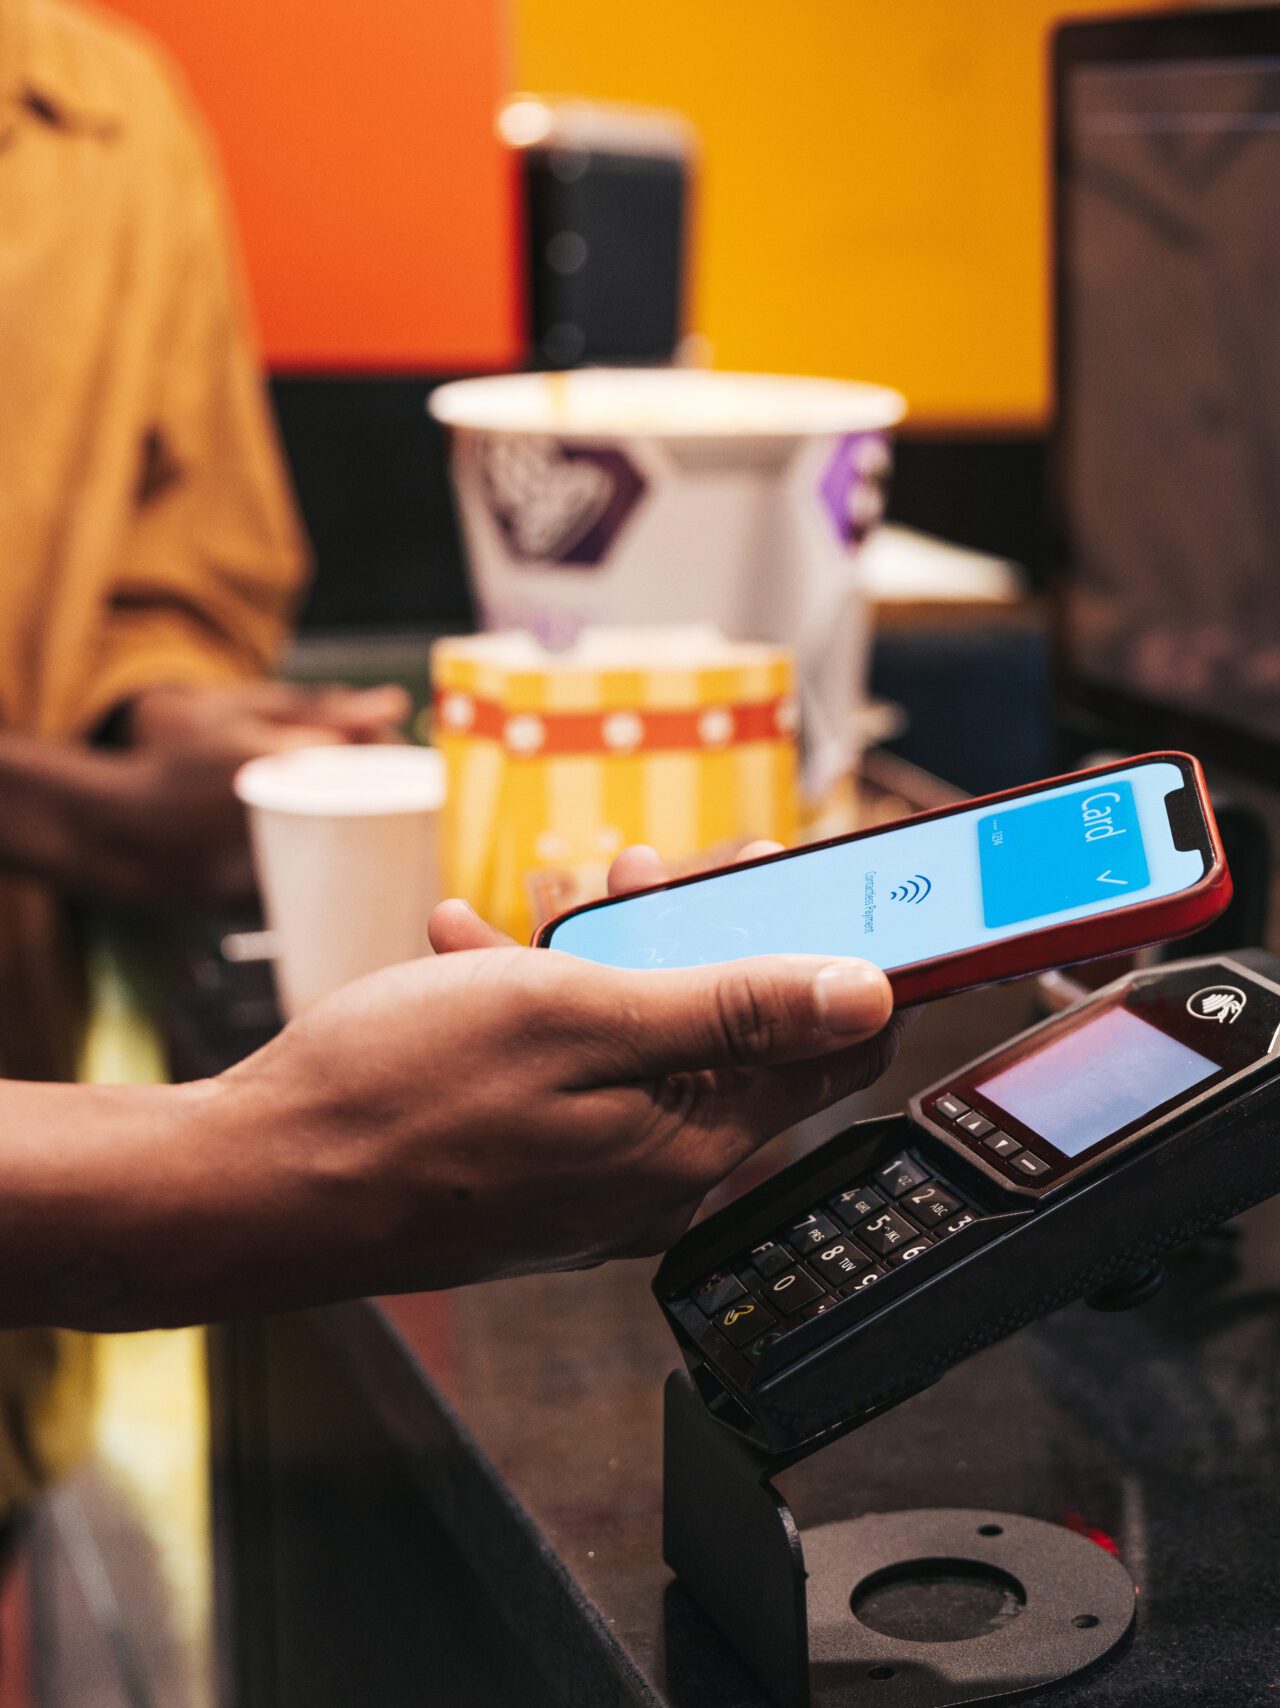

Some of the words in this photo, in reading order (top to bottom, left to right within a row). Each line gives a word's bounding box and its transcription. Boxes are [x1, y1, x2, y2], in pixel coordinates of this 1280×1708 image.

[1081, 791, 1126, 843] Card
[864, 871, 876, 906] Contactless
[882, 1160, 902, 1175] 1
[840, 1187, 860, 1203] 4
[911, 1187, 936, 1204] 2
[929, 1202, 949, 1217] ABC
[793, 1215, 816, 1229] 7
[866, 1214, 891, 1232] 5
[947, 1215, 973, 1232] 3
[808, 1228, 825, 1243] PRS
[885, 1230, 901, 1243] JKL
[820, 1244, 845, 1261] 8
[902, 1245, 927, 1261] 6
[838, 1257, 857, 1272] TUV
